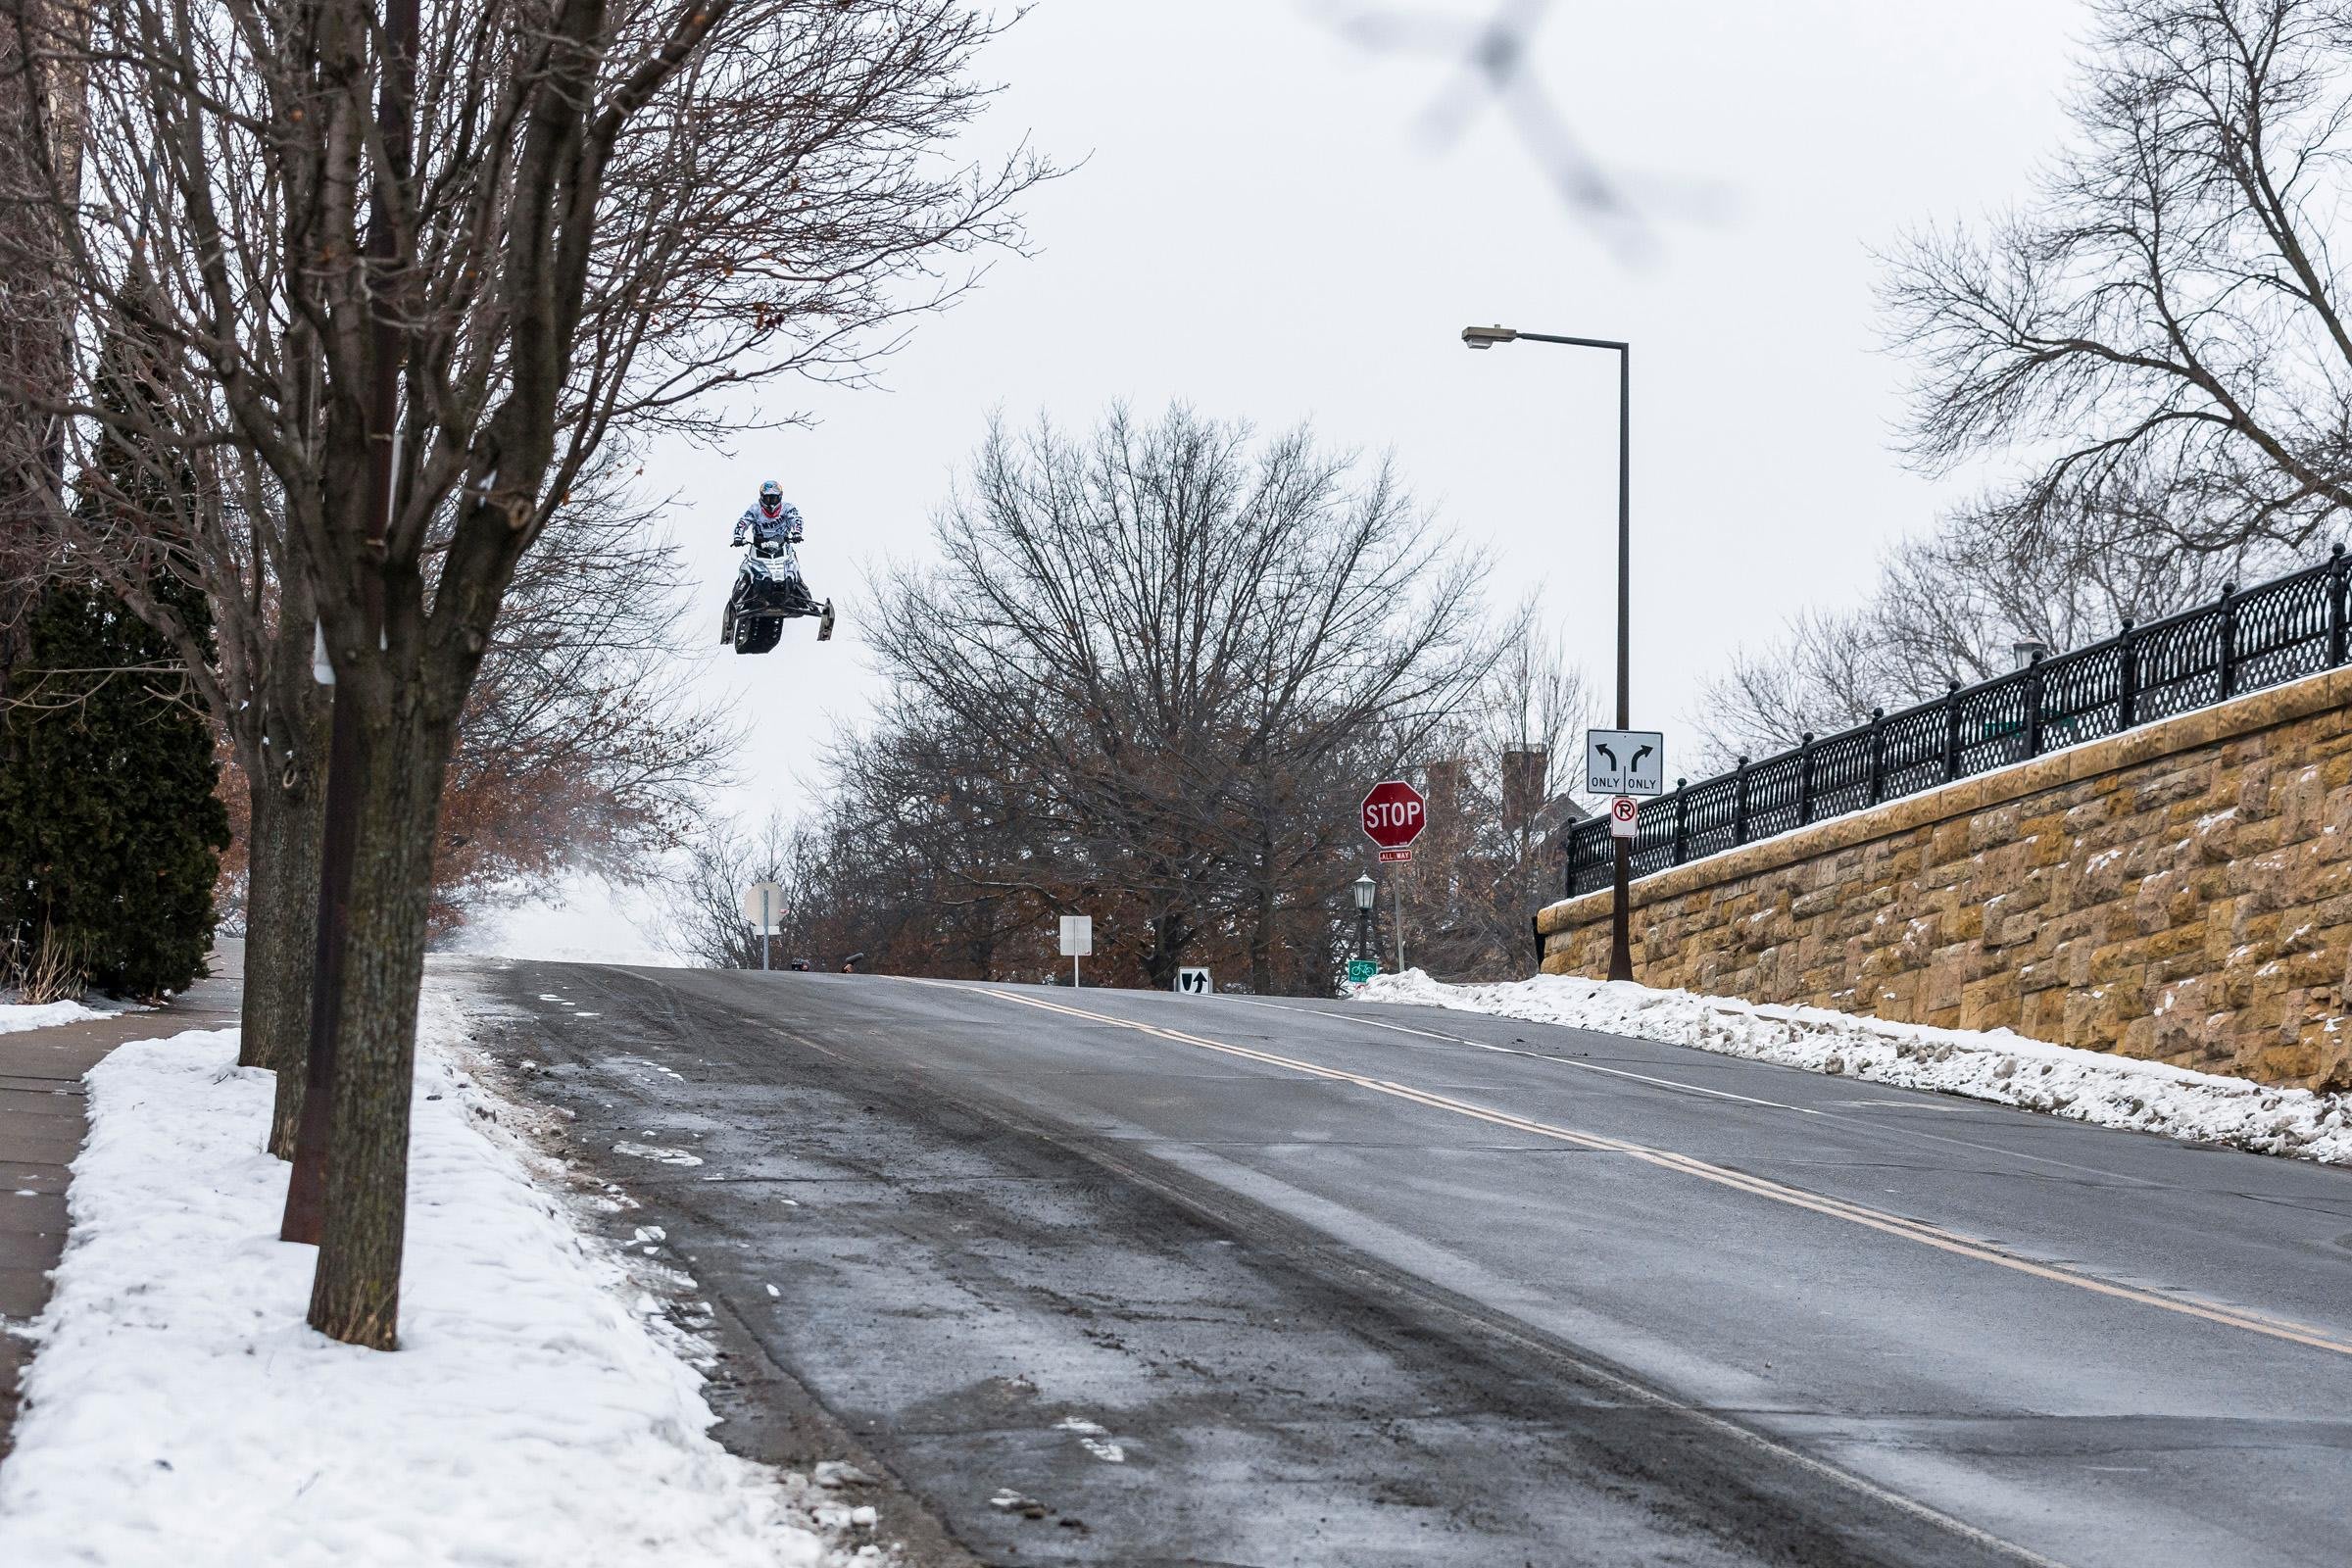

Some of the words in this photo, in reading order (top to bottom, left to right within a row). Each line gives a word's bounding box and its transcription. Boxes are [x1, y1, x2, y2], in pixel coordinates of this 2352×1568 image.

[1592, 777, 1620, 788] ONLY
[1628, 778, 1656, 789] ONLY
[1366, 801, 1421, 829] STOP
